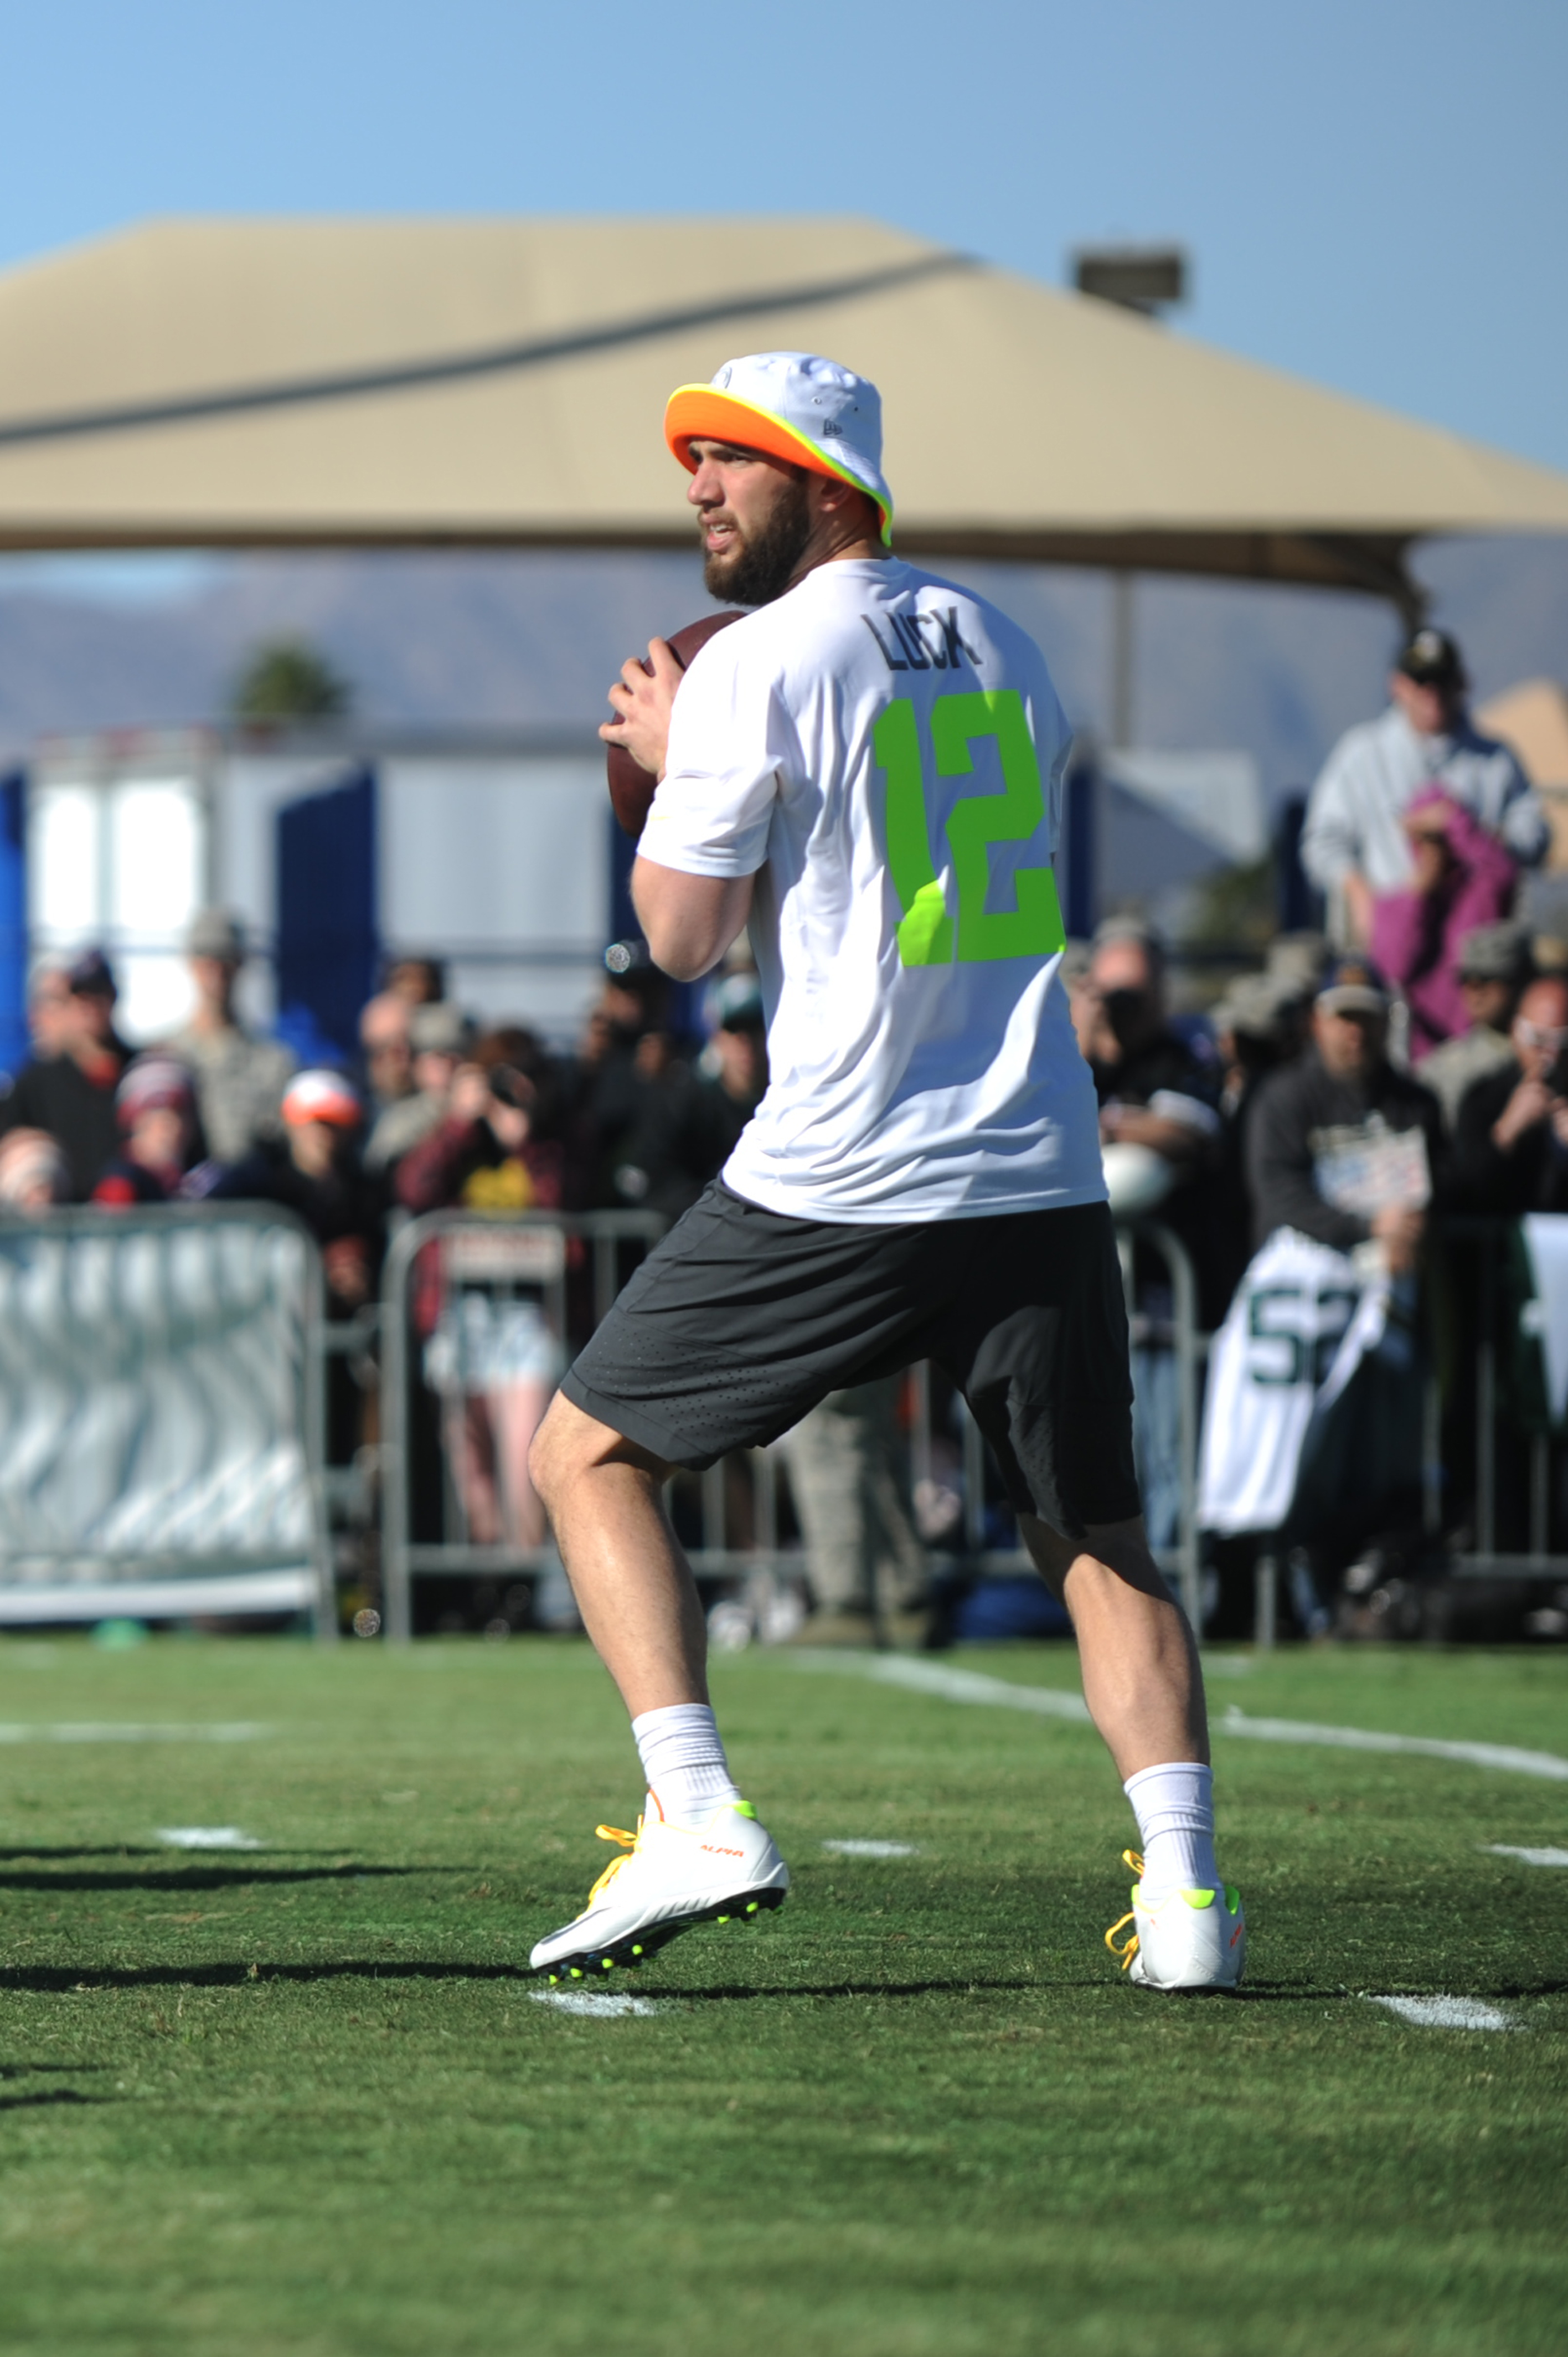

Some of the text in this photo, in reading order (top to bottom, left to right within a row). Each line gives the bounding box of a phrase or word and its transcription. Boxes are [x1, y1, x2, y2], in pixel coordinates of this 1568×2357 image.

[860, 606, 983, 670] LUCK
[871, 689, 1066, 967] 12
[700, 1844, 744, 1857] ALPHA
